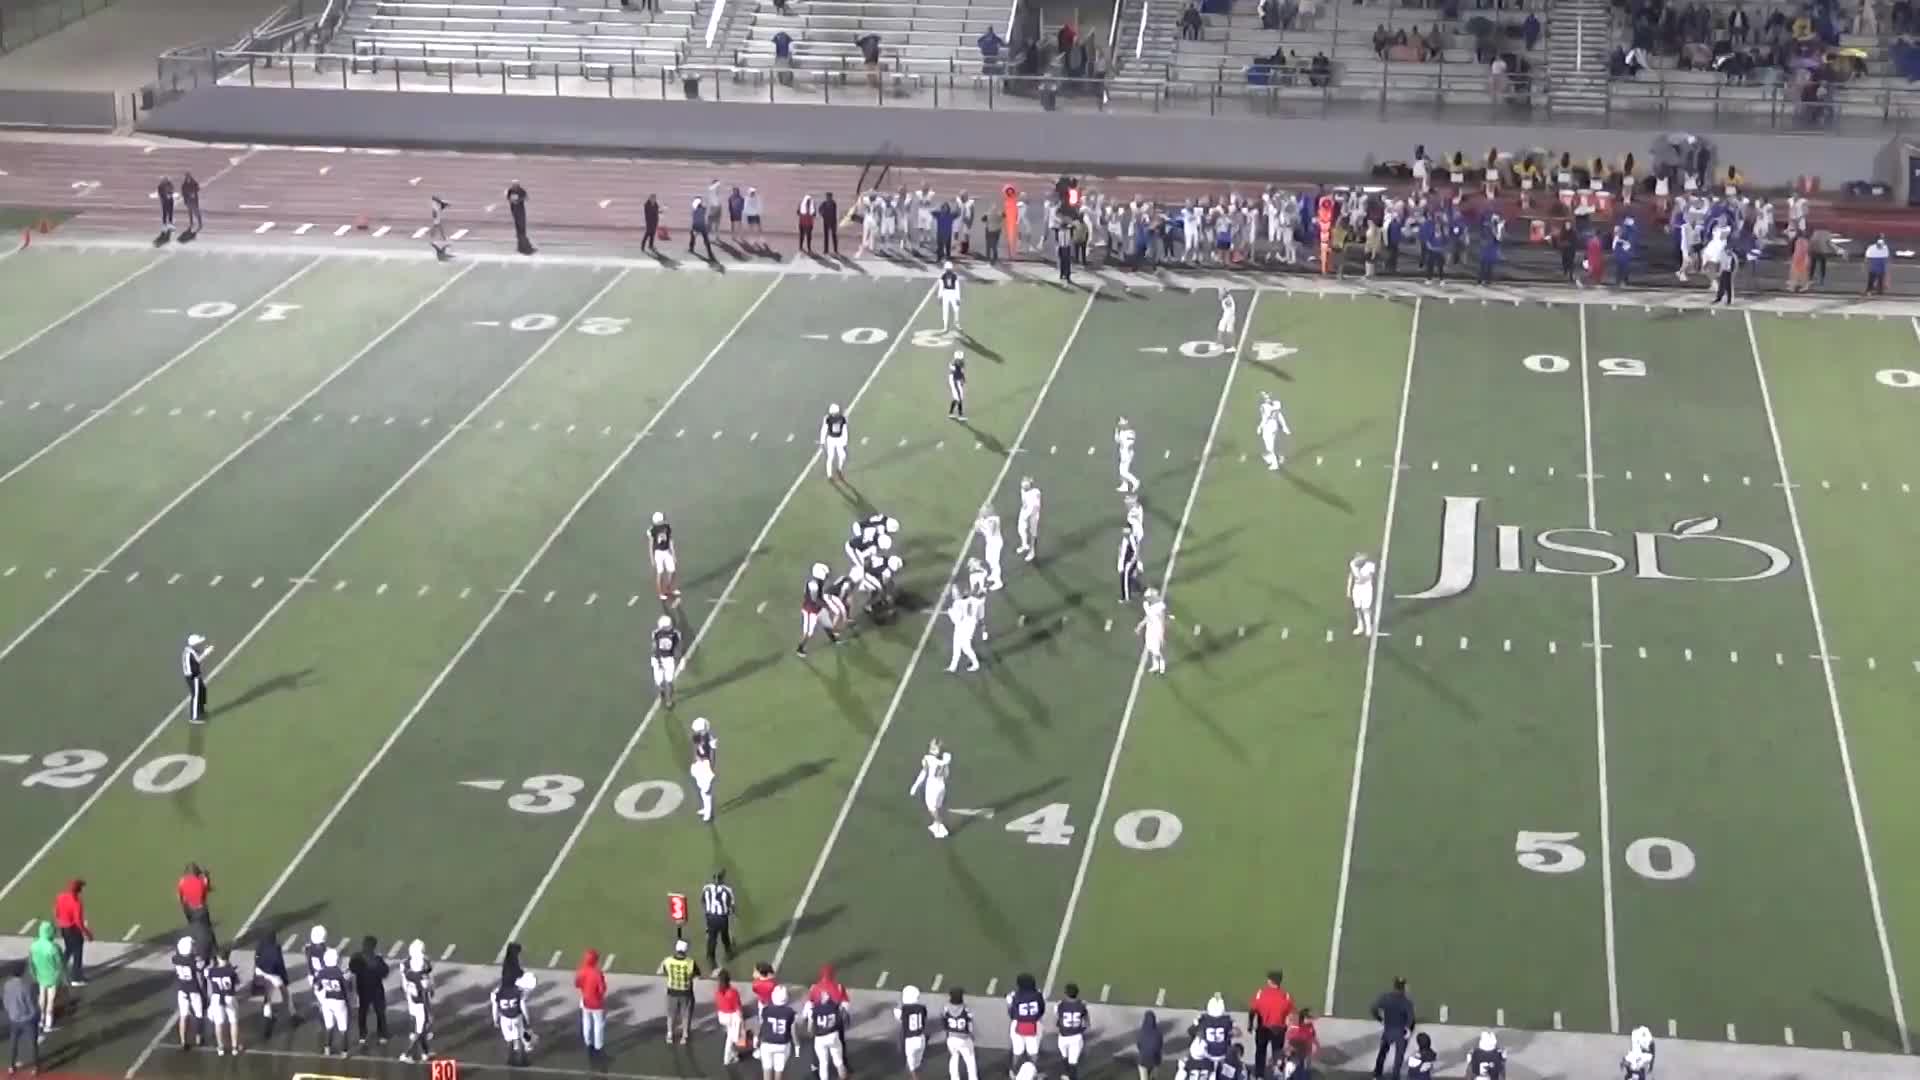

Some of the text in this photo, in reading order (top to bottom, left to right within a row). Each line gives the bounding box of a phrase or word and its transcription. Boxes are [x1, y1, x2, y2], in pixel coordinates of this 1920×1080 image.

[1394, 495, 1792, 600] JISD
[22, 748, 207, 793] 20
[507, 774, 685, 820] 30
[1005, 803, 1183, 850] 40
[1515, 830, 1696, 880] 50
[767, 1016, 787, 1034] 73
